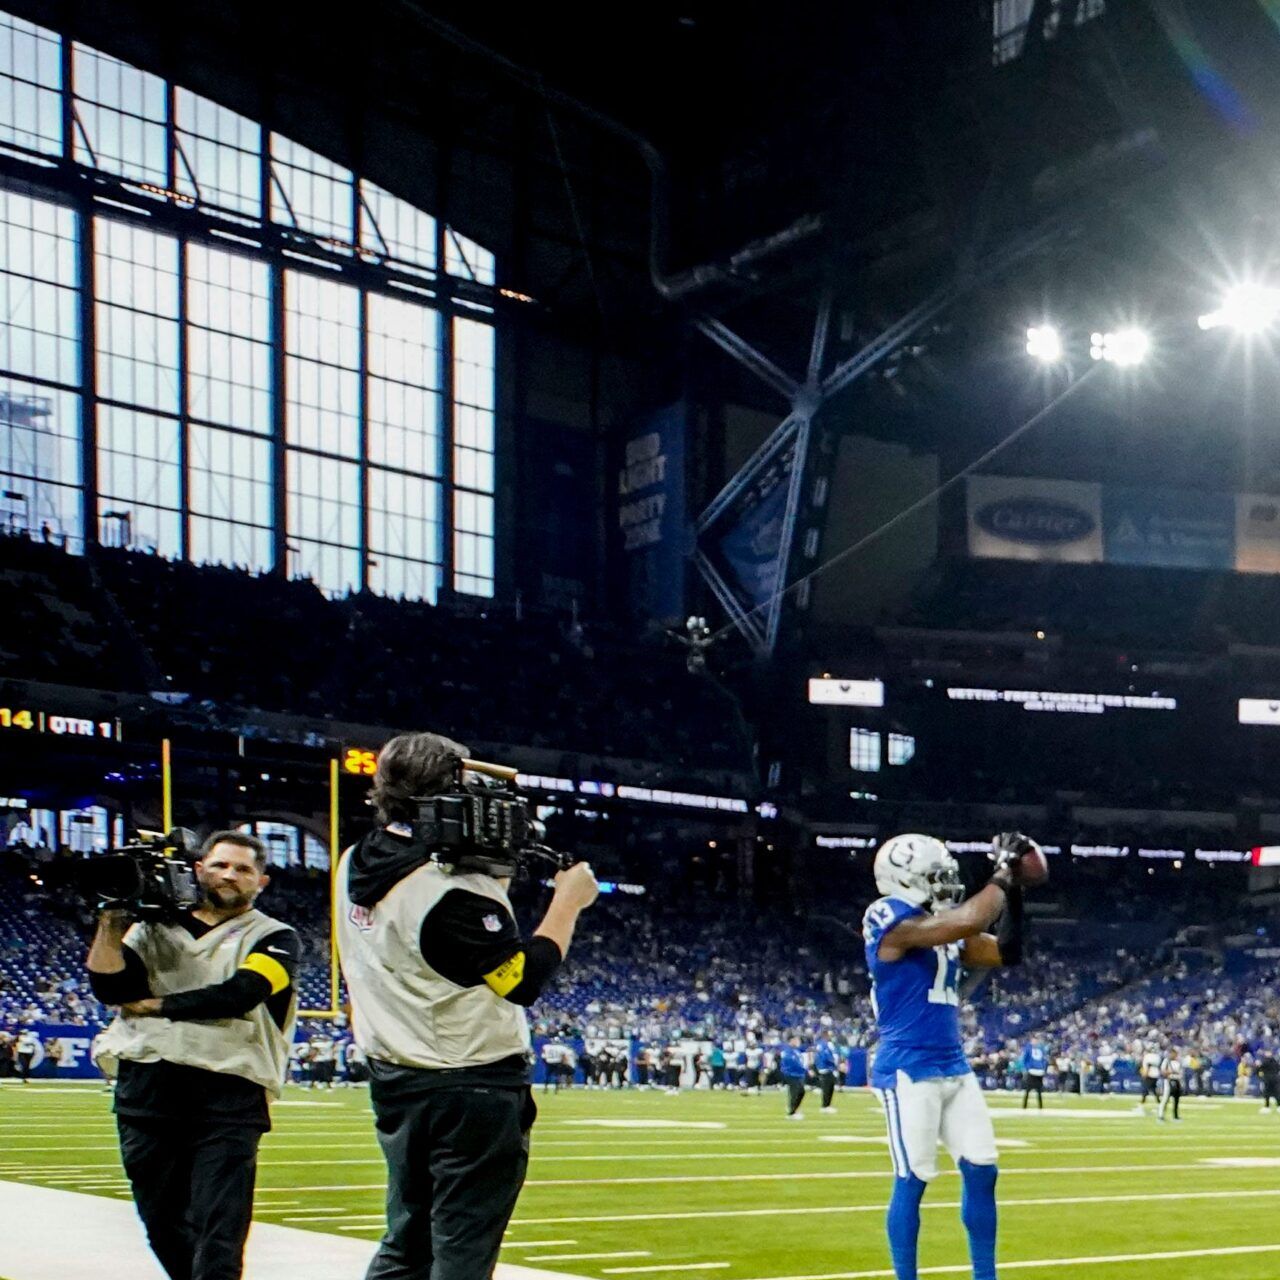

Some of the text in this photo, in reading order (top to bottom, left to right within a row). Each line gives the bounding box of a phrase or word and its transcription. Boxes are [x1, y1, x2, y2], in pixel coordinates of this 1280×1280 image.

[49, 716, 95, 736] QTR
[99, 722, 112, 738] 1
[345, 749, 377, 775] 25
